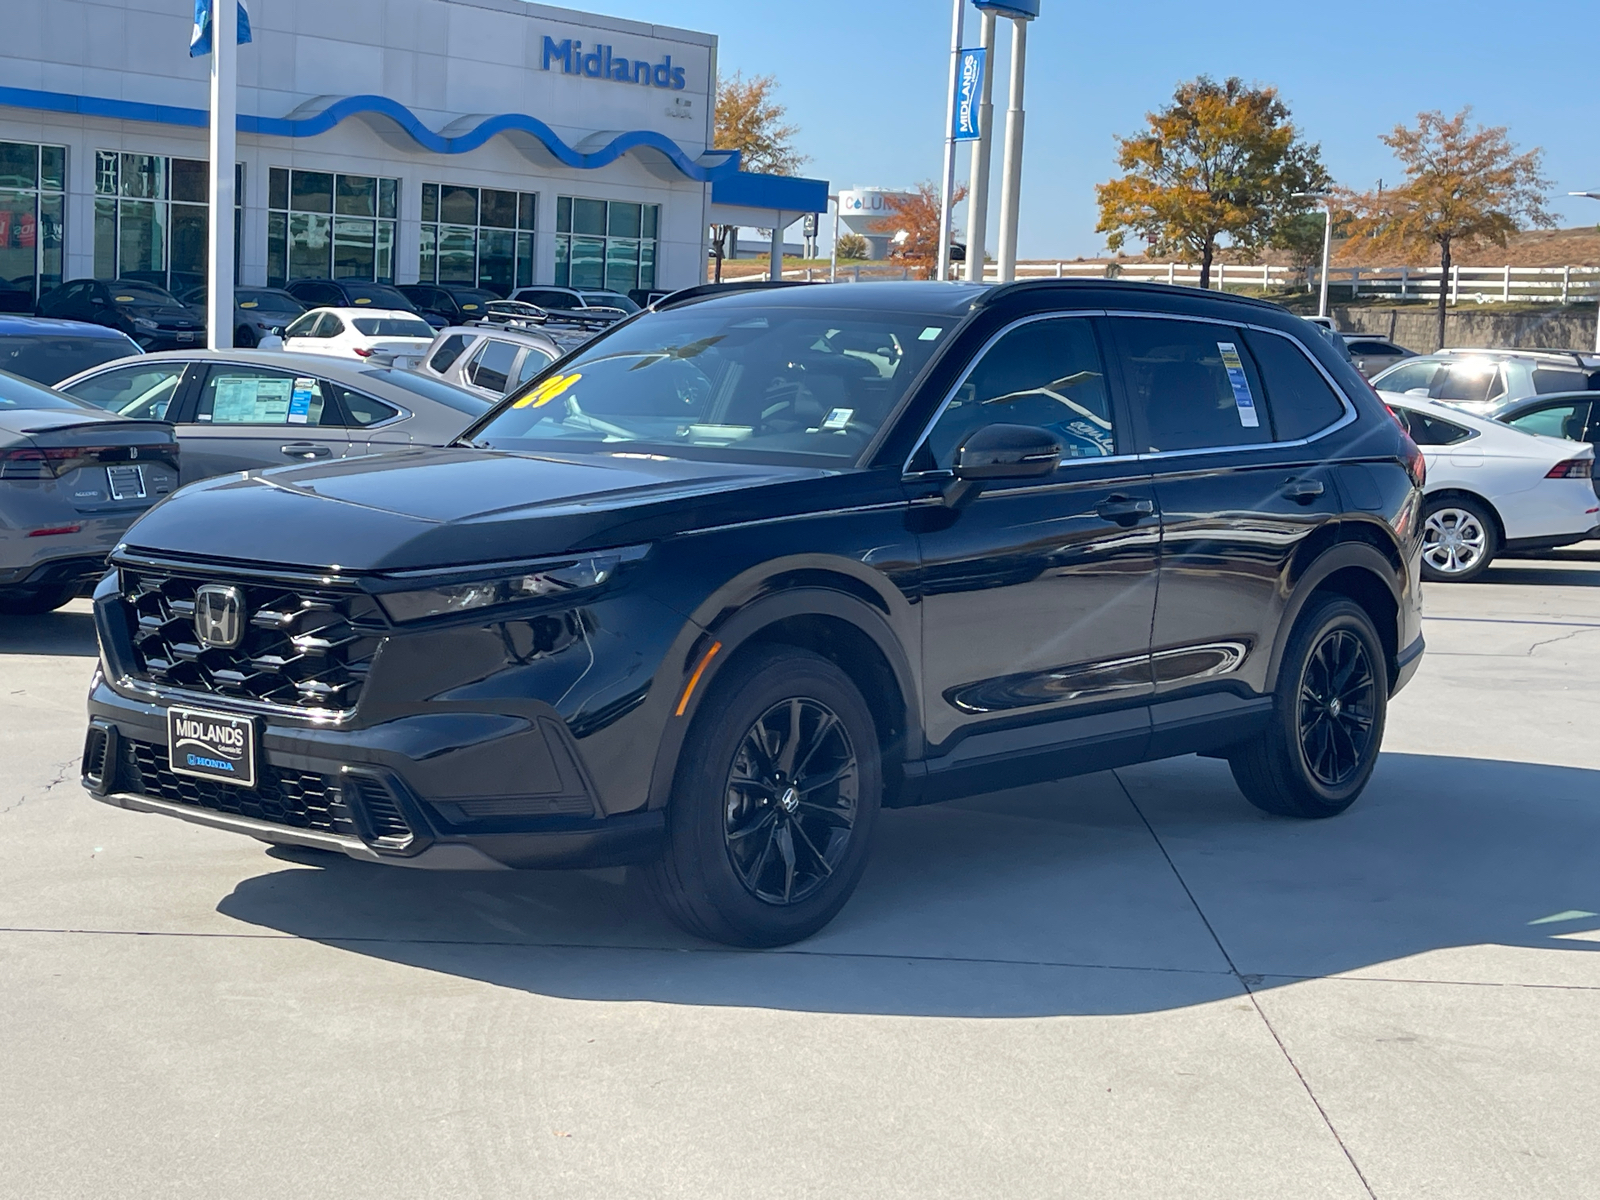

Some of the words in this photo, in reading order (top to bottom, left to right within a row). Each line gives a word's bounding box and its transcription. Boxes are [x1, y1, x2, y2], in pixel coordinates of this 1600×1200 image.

[542, 35, 686, 90] Midlands
[960, 54, 975, 132] MIDLANDS
[175, 718, 244, 747] MIDLANDS
[195, 756, 235, 772] HONDA
